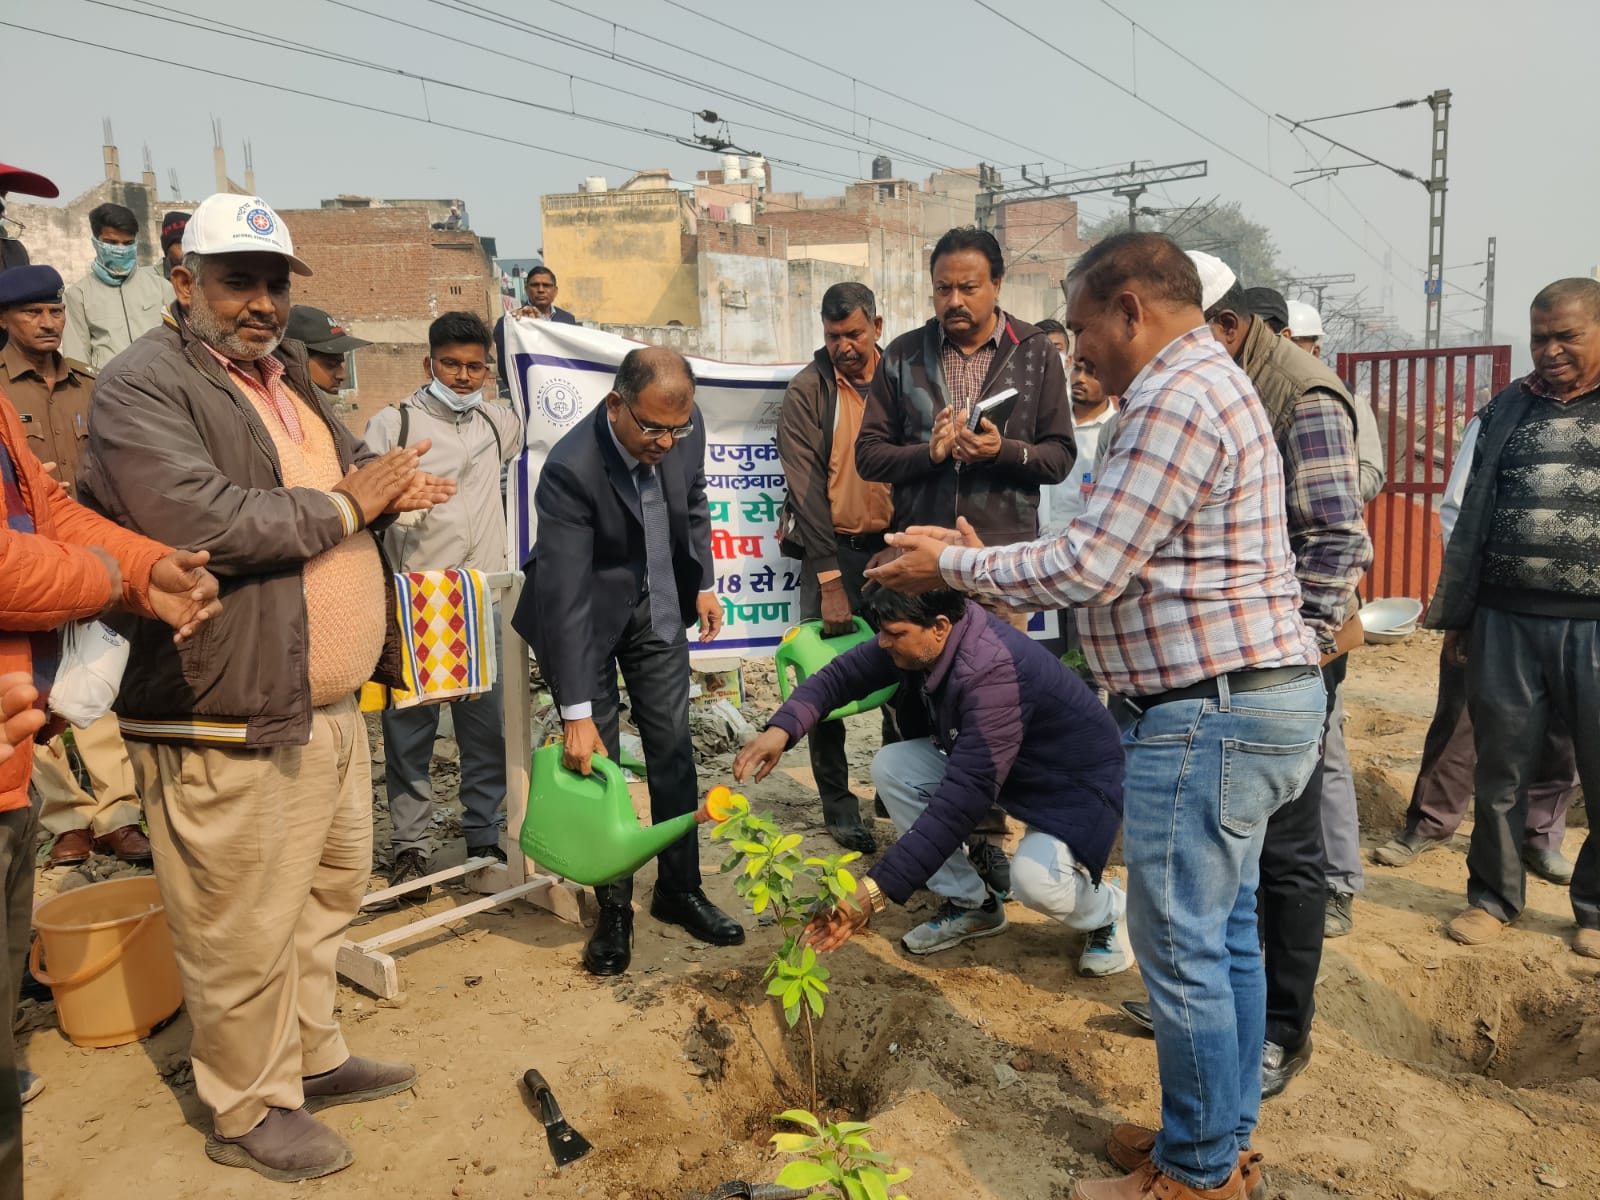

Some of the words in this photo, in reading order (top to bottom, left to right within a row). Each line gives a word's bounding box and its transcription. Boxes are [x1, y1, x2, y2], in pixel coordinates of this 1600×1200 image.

[707, 436, 779, 472] एजुके
[716, 573, 742, 594] 18
[749, 564, 776, 593] से
